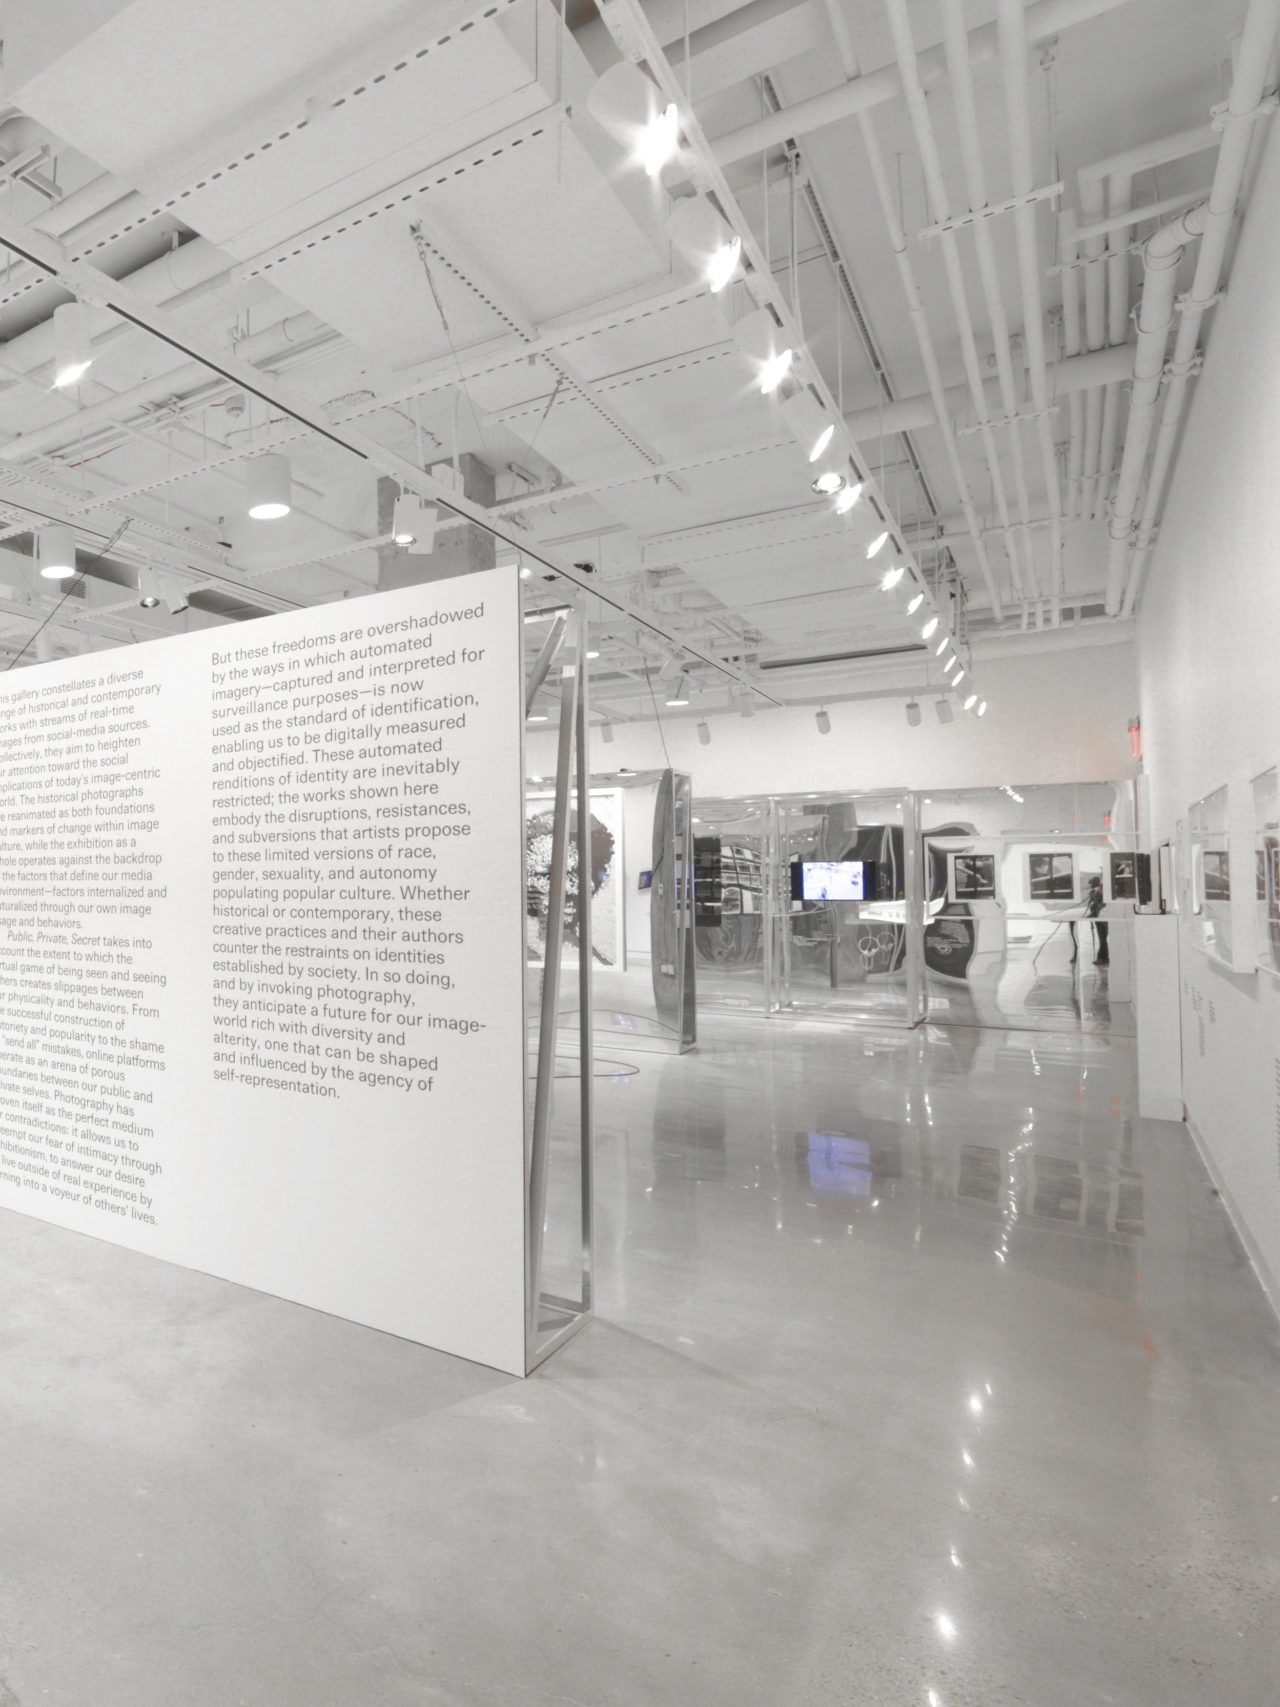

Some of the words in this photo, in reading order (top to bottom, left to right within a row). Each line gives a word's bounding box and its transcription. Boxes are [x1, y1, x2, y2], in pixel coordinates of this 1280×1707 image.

[211, 651, 231, 665] But
[235, 646, 269, 661] these
[272, 633, 336, 655] freedoms
[339, 628, 363, 642] are
[367, 601, 484, 637] overshadowed
[212, 670, 225, 686] by
[228, 666, 248, 680] the
[251, 662, 285, 677] ways
[288, 657, 300, 671] in
[303, 648, 345, 668] which
[349, 632, 432, 660] automated
[337, 664, 364, 682] and
[369, 649, 456, 677] interpreted
[461, 647, 485, 663] for
[11, 688, 40, 705] gallery
[41, 678, 96, 696] constellates
[106, 669, 144, 684] diverse
[211, 699, 288, 719] surveillance
[390, 679, 424, 694] now
[212, 721, 240, 737] used
[244, 721, 258, 733] as
[262, 716, 283, 731] the
[286, 706, 347, 728] standard
[351, 704, 366, 720] of
[370, 693, 478, 717] identification,
[211, 738, 264, 754] enabling
[268, 737, 283, 748] us
[286, 734, 300, 746] to
[304, 730, 320, 745] be
[324, 723, 382, 745] digitally
[386, 712, 466, 736] measured
[212, 758, 234, 772] and
[237, 751, 308, 772] objectified.
[312, 748, 354, 763] These
[358, 736, 442, 759] automated
[212, 775, 275, 790] renditions
[278, 771, 291, 785] of
[296, 767, 348, 784] identity
[352, 767, 376, 779] are
[382, 757, 460, 777] inevitably
[212, 791, 274, 808] restricted;
[278, 790, 299, 804] the
[302, 786, 345, 802] works
[349, 784, 398, 799] shown
[403, 781, 439, 796] here
[212, 811, 261, 828] embody
[264, 810, 285, 823] the
[288, 806, 371, 825] disruptions,
[376, 802, 471, 818] resistances,
[212, 830, 235, 844] and
[238, 828, 316, 843] subversions
[319, 826, 348, 840] that
[352, 824, 400, 839] artists
[404, 824, 471, 842] propose
[18, 855, 56, 868] operates
[58, 853, 92, 868] against
[94, 852, 111, 864] the
[113, 851, 162, 867] backdrop
[212, 850, 224, 862] to
[227, 849, 261, 862] these
[264, 846, 309, 861] limited
[313, 846, 374, 860] versions
[377, 844, 393, 859] of
[397, 847, 436, 860] race,
[212, 867, 258, 884] gender,
[262, 866, 324, 883] sexuality,
[328, 865, 355, 879] and
[359, 866, 437, 883] autonomy
[213, 885, 278, 902] populating
[283, 885, 335, 903] popular
[339, 885, 395, 900] culture.
[400, 885, 471, 900] Whether
[213, 903, 269, 917] historical
[272, 907, 286, 918] or
[289, 906, 393, 924] contemporary,
[398, 906, 442, 921] these
[7, 930, 34, 943] Public,
[36, 931, 68, 945] Private,
[70, 933, 101, 946] Secret
[102, 935, 130, 947] takes
[132, 936, 153, 949] into
[212, 922, 262, 936] creative
[265, 924, 327, 940] practices
[330, 925, 357, 940] and
[362, 926, 397, 941] their
[401, 927, 464, 944] authors
[212, 942, 258, 954] counter
[261, 942, 282, 956] the
[285, 944, 349, 959] restraints
[352, 949, 370, 960] on
[375, 947, 445, 964] identities
[19, 963, 44, 975] game
[46, 963, 55, 974] of
[57, 964, 83, 980] being
[85, 969, 108, 979] seen
[110, 969, 130, 981] and
[132, 971, 167, 988] seeing
[212, 959, 284, 975] established
[288, 962, 304, 980] by
[307, 964, 360, 984] society.
[365, 966, 378, 981] In
[383, 971, 401, 983] so
[405, 969, 455, 991] doing,
[213, 976, 235, 990] and
[239, 977, 254, 995] by
[257, 979, 312, 1000] invoking
[317, 984, 415, 1009] photography,
[213, 994, 239, 1012] they
[242, 998, 306, 1017] anticipate
[310, 1005, 318, 1016] a
[322, 1003, 366, 1021] future
[370, 1007, 392, 1024] for
[396, 1013, 423, 1027] our
[213, 1014, 247, 1028] world
[251, 1016, 274, 1031] rich
[278, 1020, 307, 1035] with
[311, 1022, 373, 1046] diversity
[377, 1030, 405, 1046] and
[213, 1030, 260, 1051] alterity,
[264, 1039, 289, 1052] one
[292, 1040, 320, 1056] that
[325, 1046, 351, 1060] can
[356, 1047, 375, 1063] be
[379, 1050, 438, 1073] shaped
[213, 1050, 236, 1063] and
[239, 1051, 306, 1074] influenced
[311, 1061, 328, 1081] by
[331, 1064, 354, 1080] the
[358, 1071, 413, 1093] agency
[417, 1076, 433, 1092] of
[213, 1068, 340, 1098] self-representation.
[22, 1085, 51, 1099] selves.
[53, 1089, 114, 1116] Photography
[116, 1101, 135, 1117] has
[49, 1152, 59, 1164] to
[60, 1157, 94, 1174] answer
[95, 1166, 112, 1179] our
[114, 1168, 146, 1187] desire
